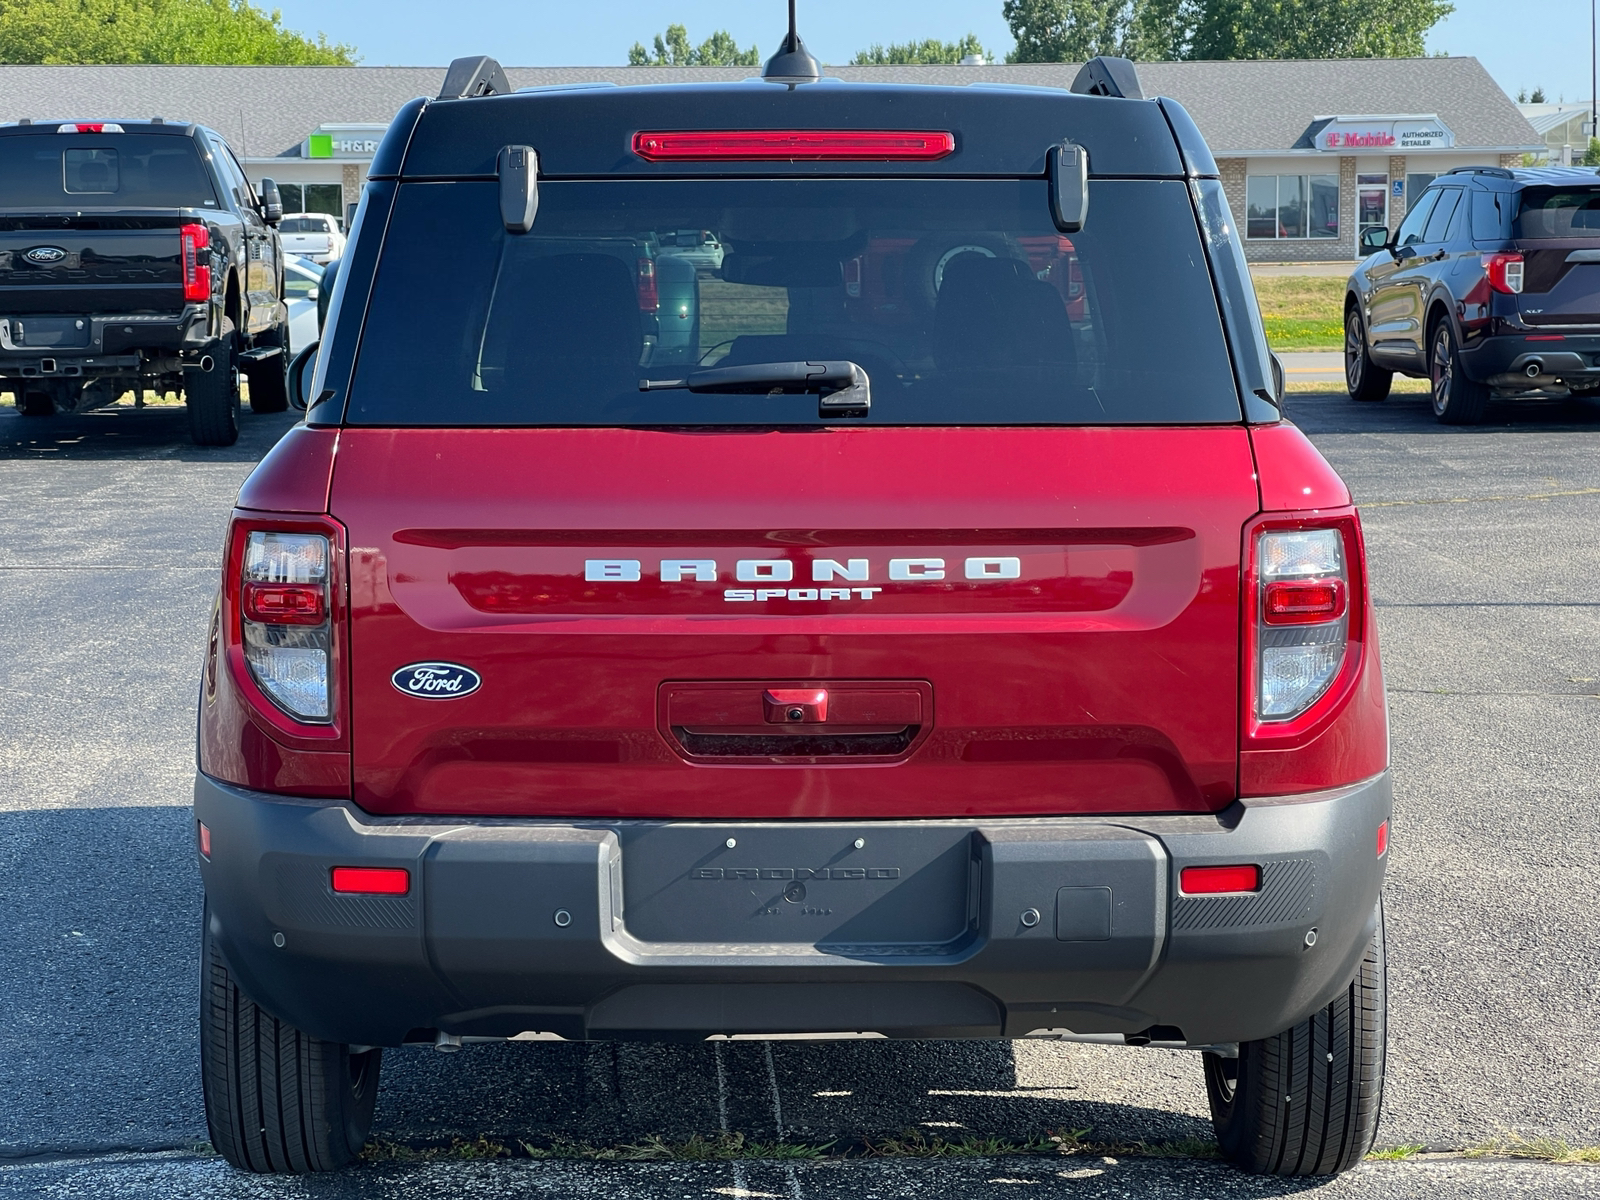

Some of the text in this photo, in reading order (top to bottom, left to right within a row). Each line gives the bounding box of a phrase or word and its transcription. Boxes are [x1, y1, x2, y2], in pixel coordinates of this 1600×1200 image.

[1401, 131, 1444, 139] AUTHORIZED
[341, 140, 376, 152] H&R
[33, 250, 57, 259] Ford
[584, 557, 1021, 582] BRONCO
[723, 587, 882, 602] SPORT
[409, 668, 463, 691] Ford
[691, 868, 899, 879] BRONCO
